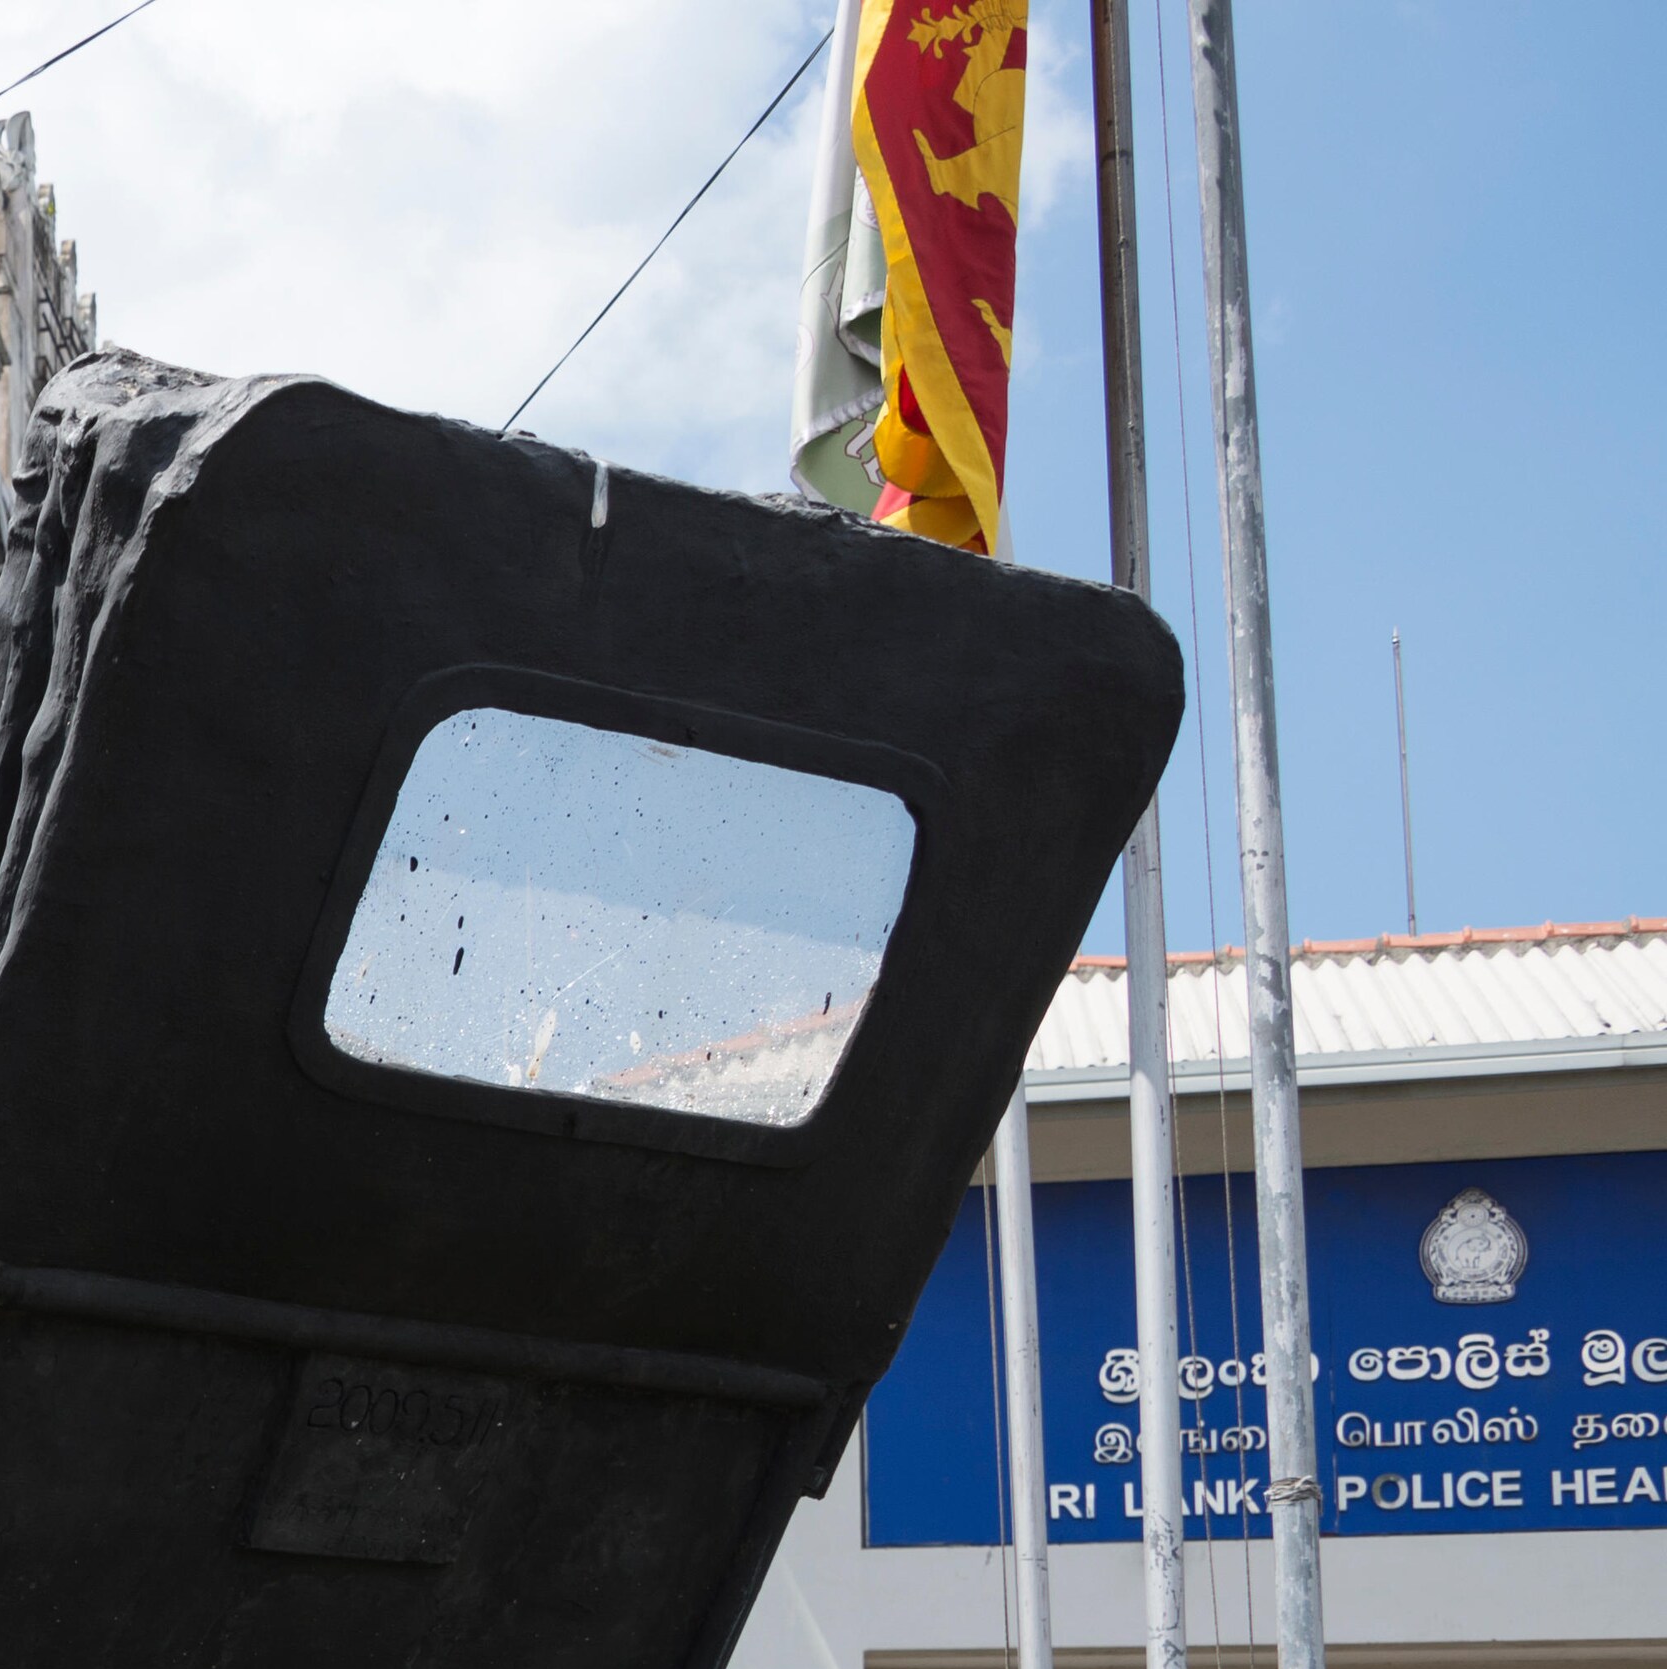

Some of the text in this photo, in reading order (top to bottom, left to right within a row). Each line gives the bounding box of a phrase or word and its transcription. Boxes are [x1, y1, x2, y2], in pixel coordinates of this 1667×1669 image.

[1348, 1328, 1551, 1390] පොලිස්
[1049, 1465, 1667, 1519] RI LNK POLICE HEA
